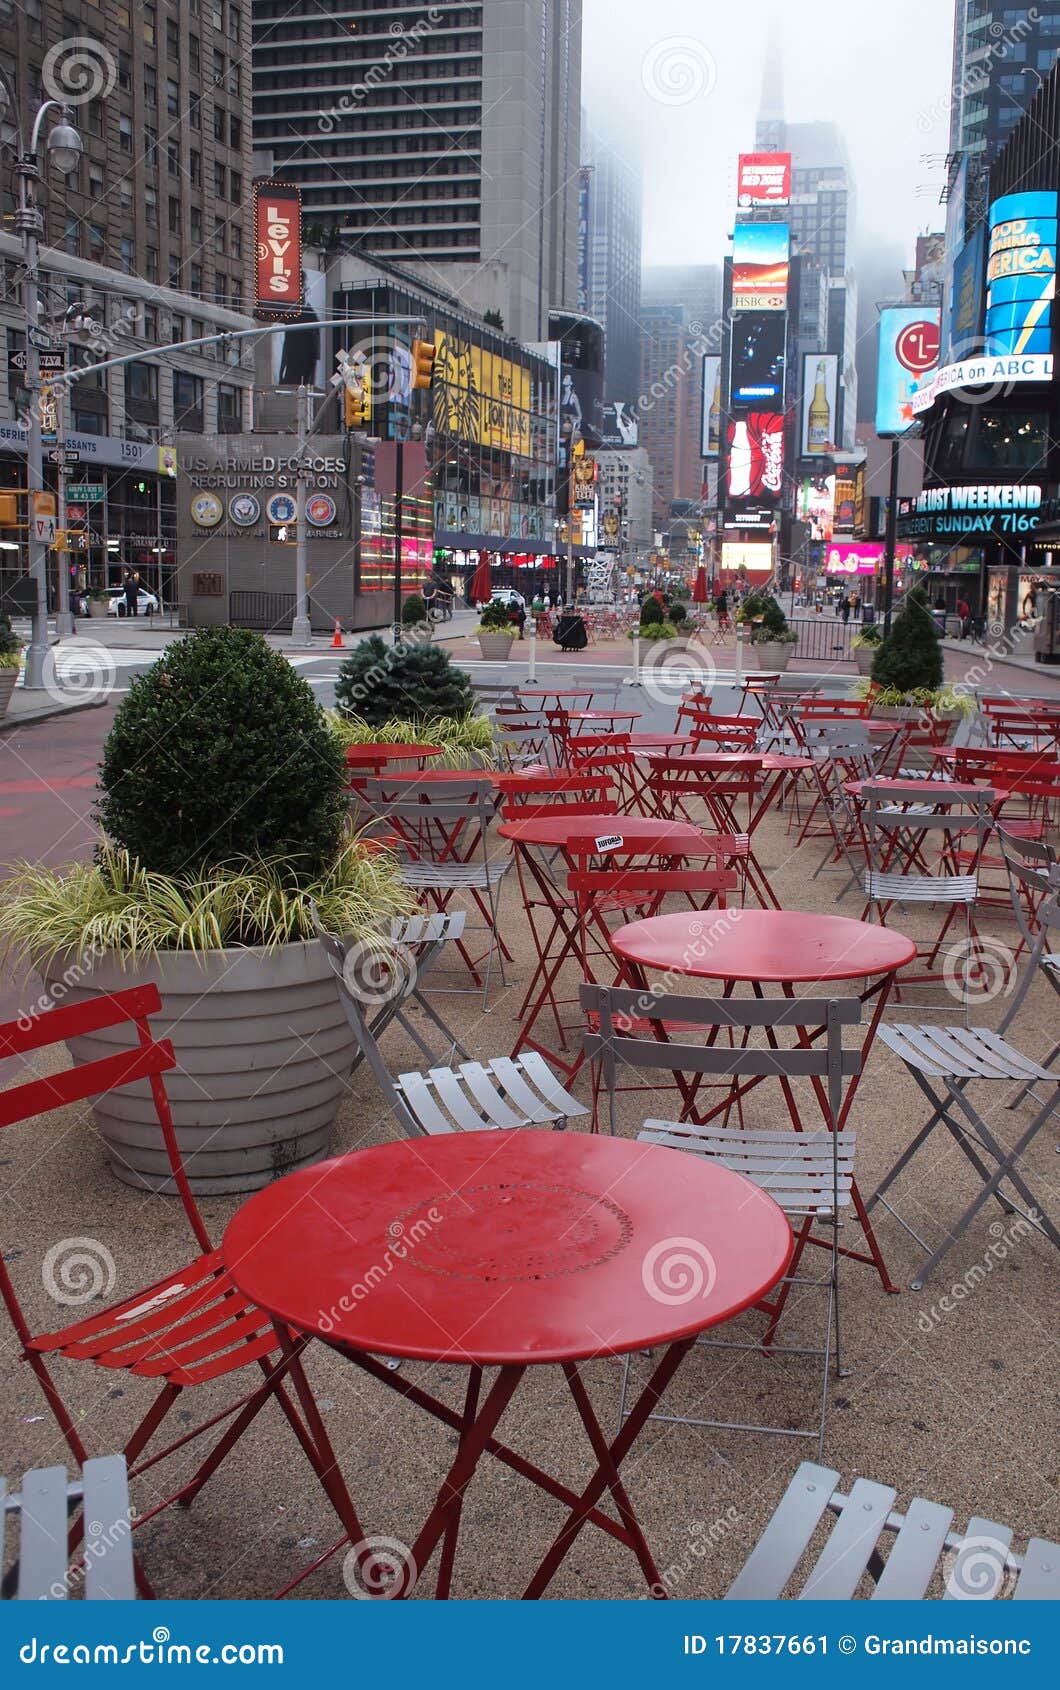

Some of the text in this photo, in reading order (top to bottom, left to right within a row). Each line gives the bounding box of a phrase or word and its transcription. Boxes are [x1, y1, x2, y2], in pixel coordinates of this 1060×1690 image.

[267, 206, 292, 293] Levi's
[988, 247, 1056, 280] ERICA
[735, 296, 768, 307] HSBC
[968, 365, 986, 378] on
[993, 359, 1036, 376] ABC
[120, 443, 143, 458] 1501
[182, 456, 209, 472] U.S.
[211, 457, 275, 472] ARMED
[191, 476, 338, 488] RECRUITING STTION
[576, 483, 594, 491] KING
[928, 487, 950, 511] LOST
[951, 485, 1042, 510] WEEKEND
[936, 515, 995, 533] SUNDAY
[306, 529, 338, 538] MARINES
